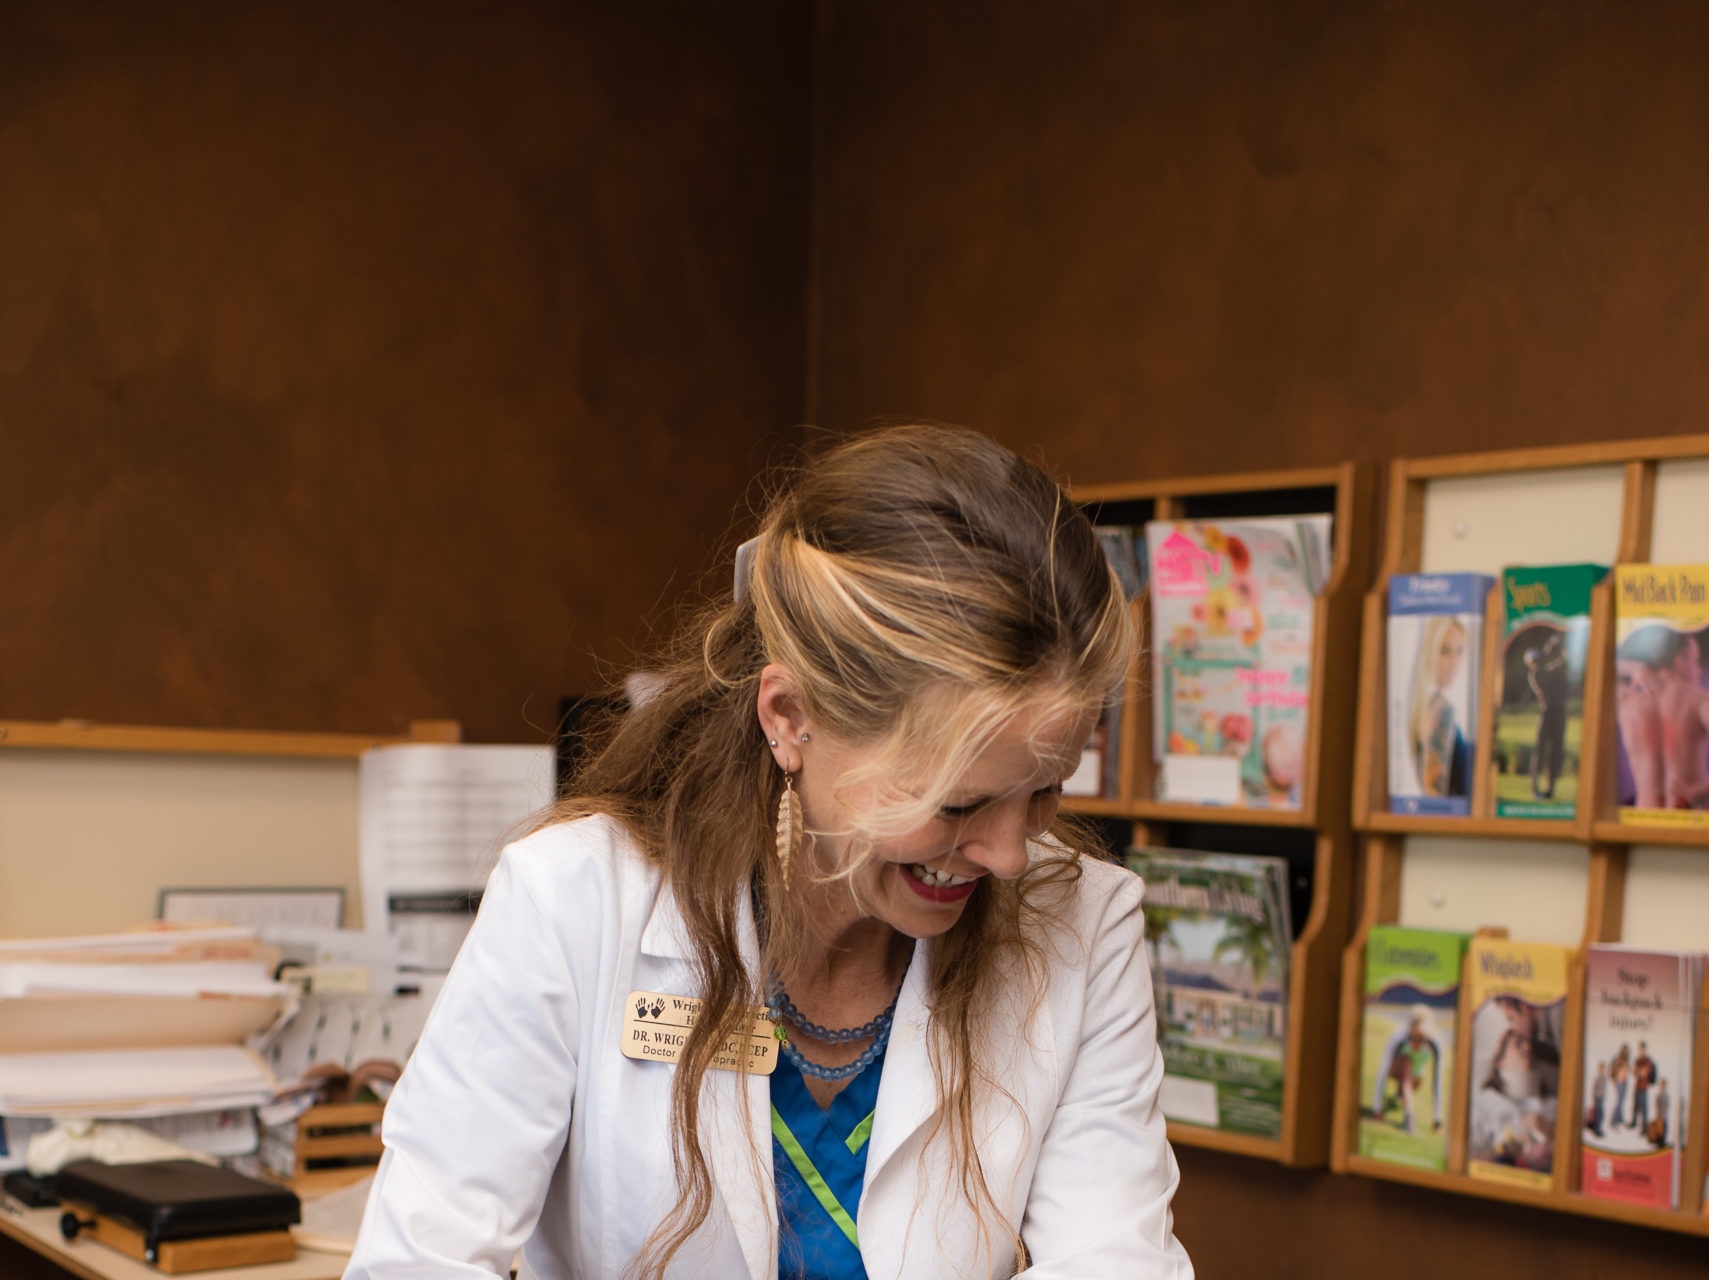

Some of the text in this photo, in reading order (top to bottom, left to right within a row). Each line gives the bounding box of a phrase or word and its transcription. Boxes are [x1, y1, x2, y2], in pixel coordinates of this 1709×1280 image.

[672, 999, 703, 1014] Wrig
[632, 1029, 650, 1042] DR.
[654, 1032, 689, 1047] WRIG
[642, 1045, 677, 1059] Doctor
